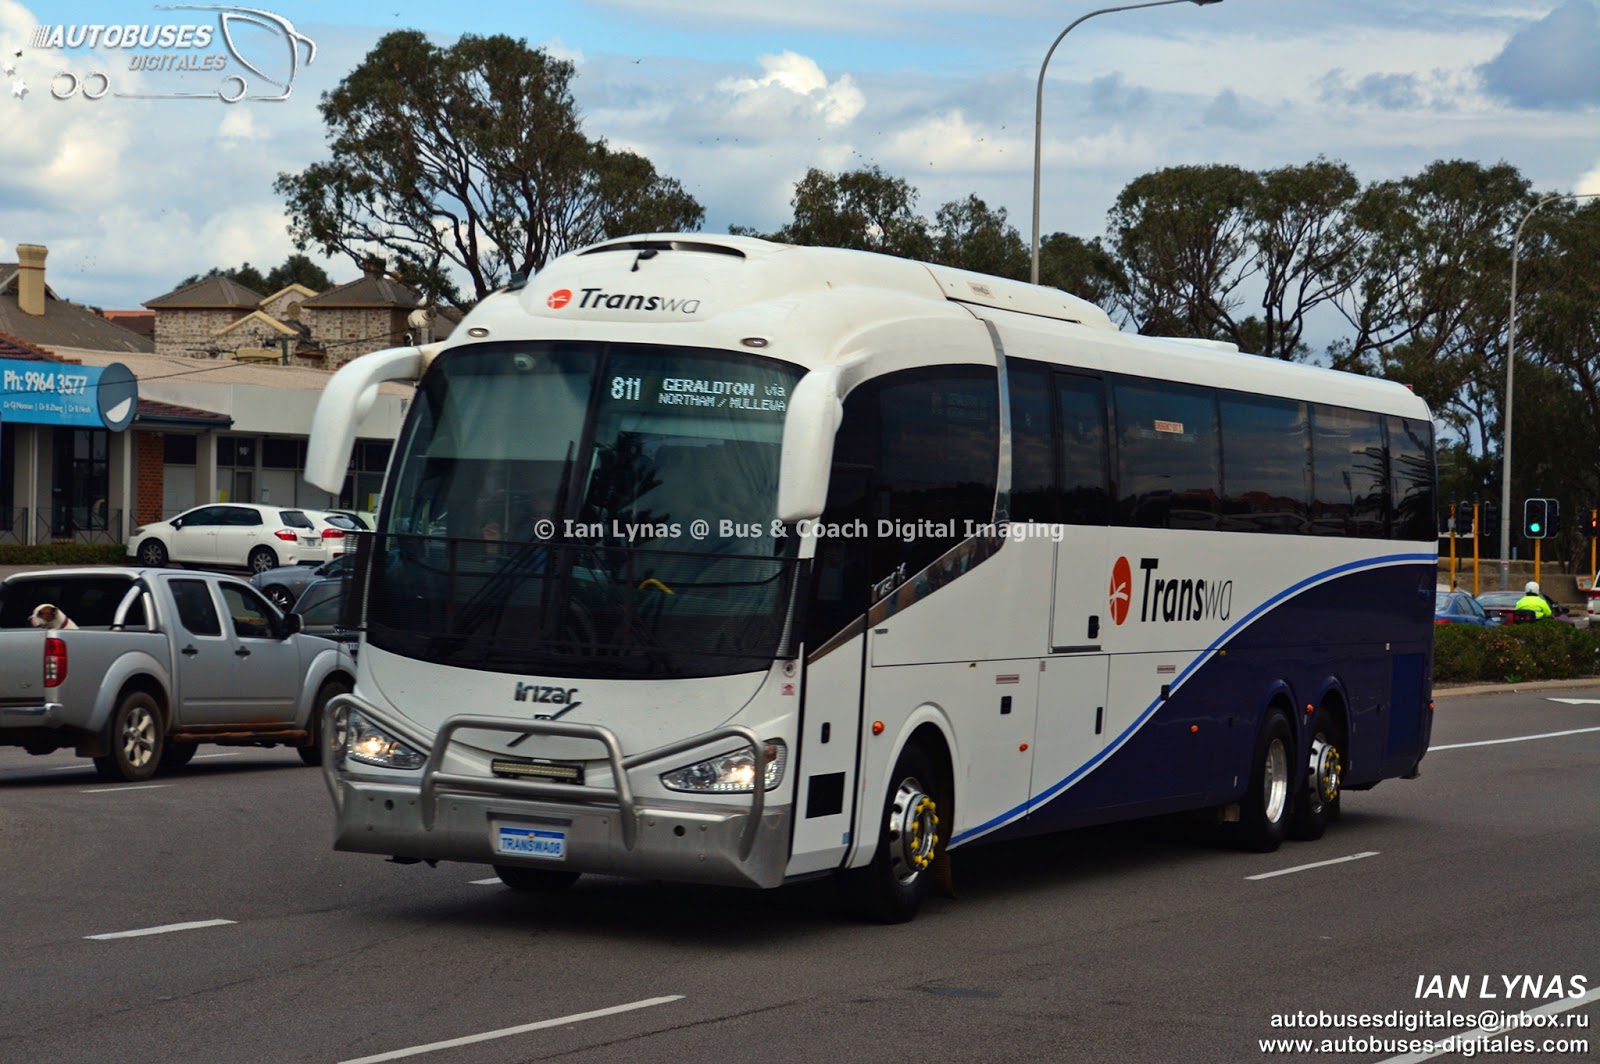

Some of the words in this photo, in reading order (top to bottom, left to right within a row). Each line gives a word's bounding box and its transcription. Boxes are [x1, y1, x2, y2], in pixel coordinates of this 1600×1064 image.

[579, 288, 700, 314] Transwa
[3, 370, 24, 392] Ph:
[25, 371, 54, 394] 9964
[57, 374, 88, 396] 3577
[611, 377, 641, 400] 811
[662, 378, 755, 397] GERALDTON
[764, 383, 787, 398] via
[659, 393, 715, 407] NORTHAM
[729, 398, 787, 412] MULLEWA
[1140, 558, 1232, 622] Transwa
